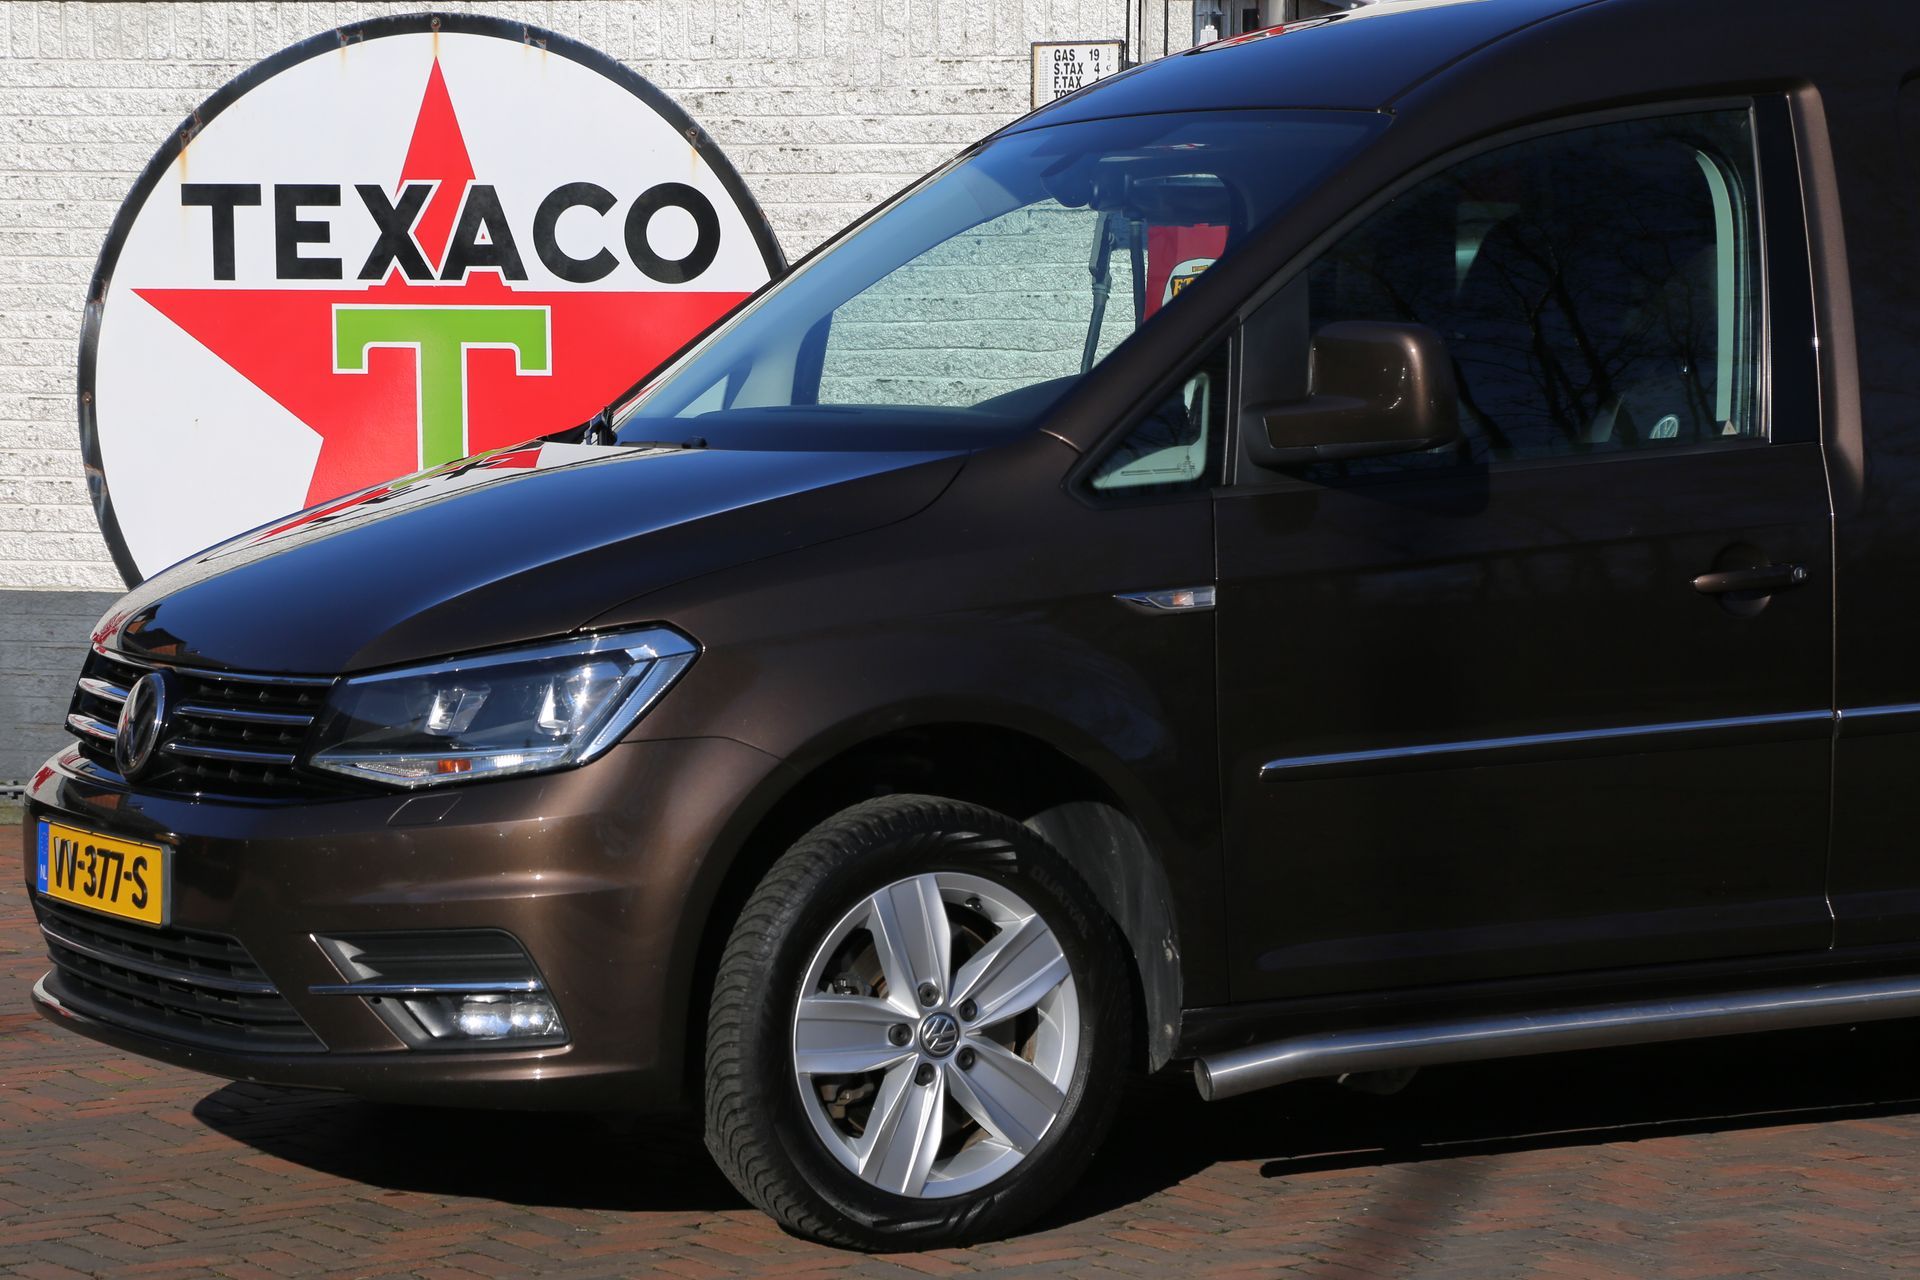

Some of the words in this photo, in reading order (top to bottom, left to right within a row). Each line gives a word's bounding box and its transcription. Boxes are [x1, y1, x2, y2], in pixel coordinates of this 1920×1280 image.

[1053, 48, 1075, 62] GAS
[1089, 48, 1100, 61] 19
[1053, 62, 1084, 75] S.TAX
[1094, 62, 1100, 74] 4
[1053, 76, 1082, 89] F.TAX
[180, 181, 721, 284] TEXACO
